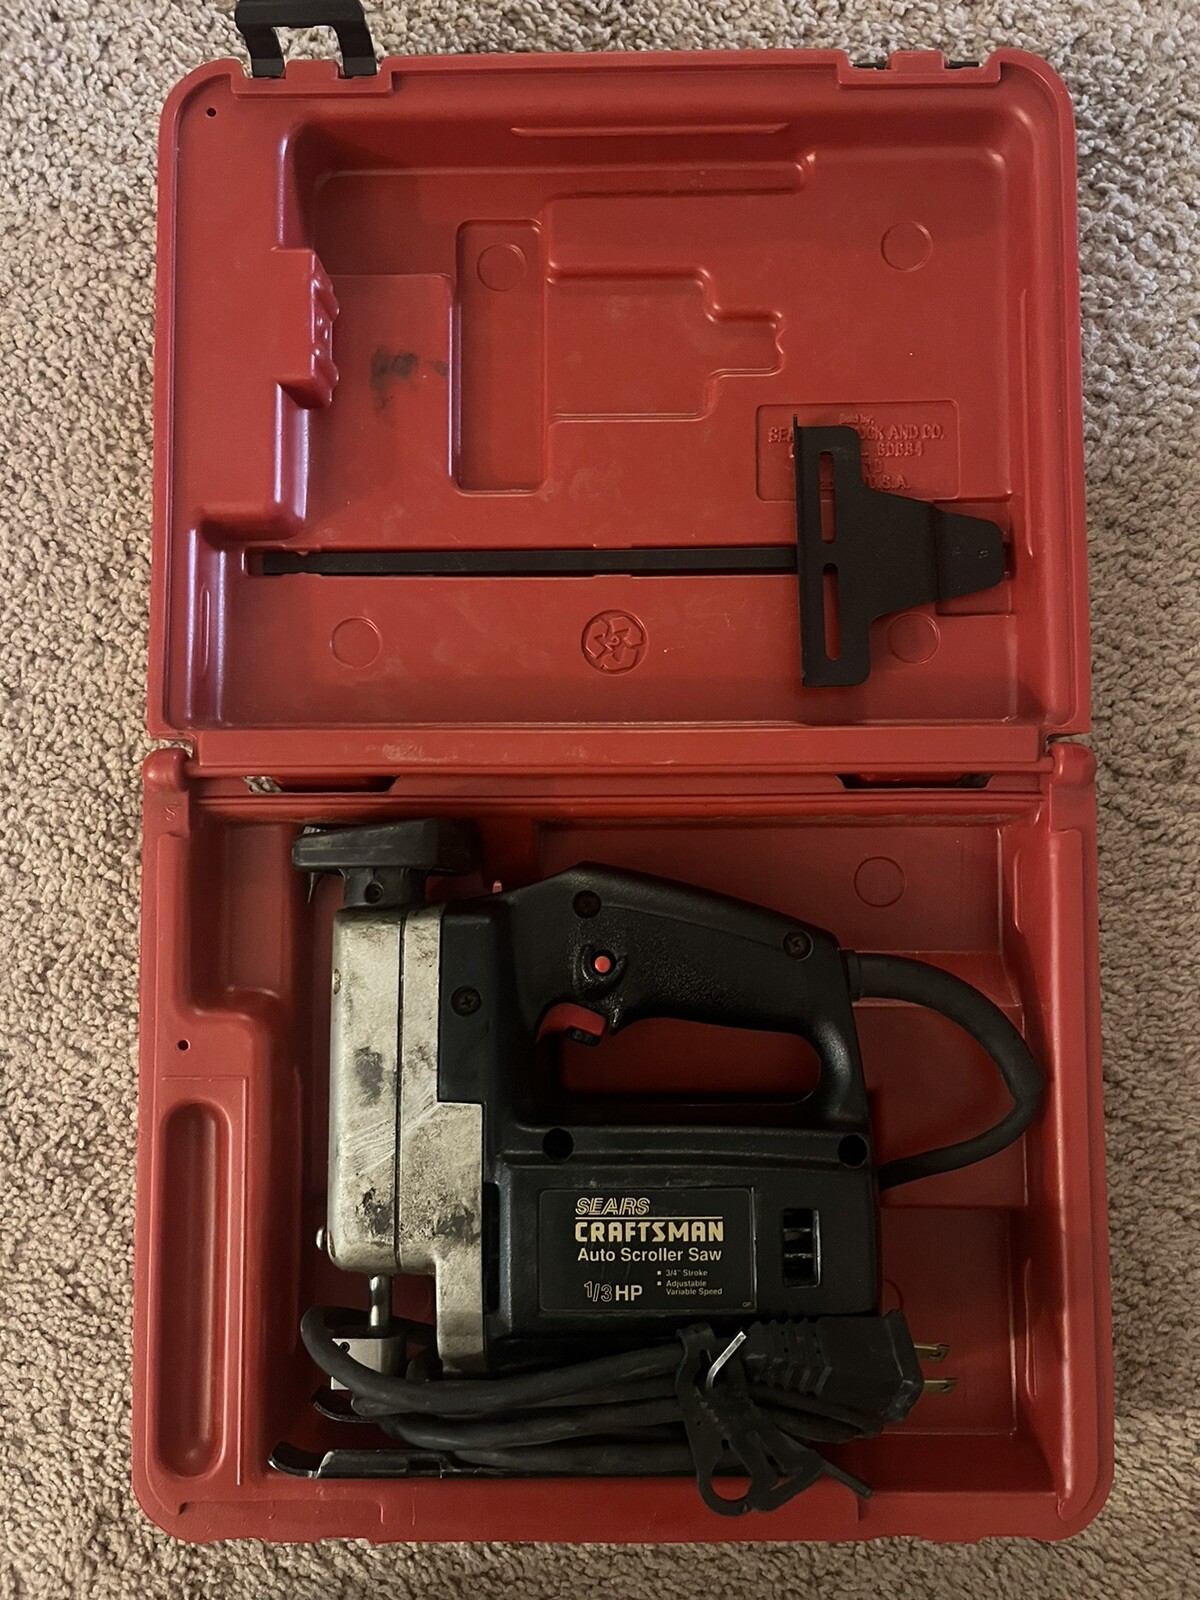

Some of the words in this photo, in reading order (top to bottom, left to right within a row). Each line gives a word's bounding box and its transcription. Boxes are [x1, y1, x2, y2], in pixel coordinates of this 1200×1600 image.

[887, 424, 918, 440] AND
[575, 1197, 651, 1215] SEARS
[575, 1221, 724, 1242] CRAFTSMAN
[577, 1247, 616, 1262] Auto
[620, 1247, 684, 1262] Scroller
[688, 1247, 722, 1262] Saw
[683, 1268, 708, 1277] Stroke
[666, 1280, 707, 1288] Adjustable
[615, 1284, 643, 1302] HP
[666, 1288, 697, 1296] Variable
[698, 1288, 723, 1297] Speed
